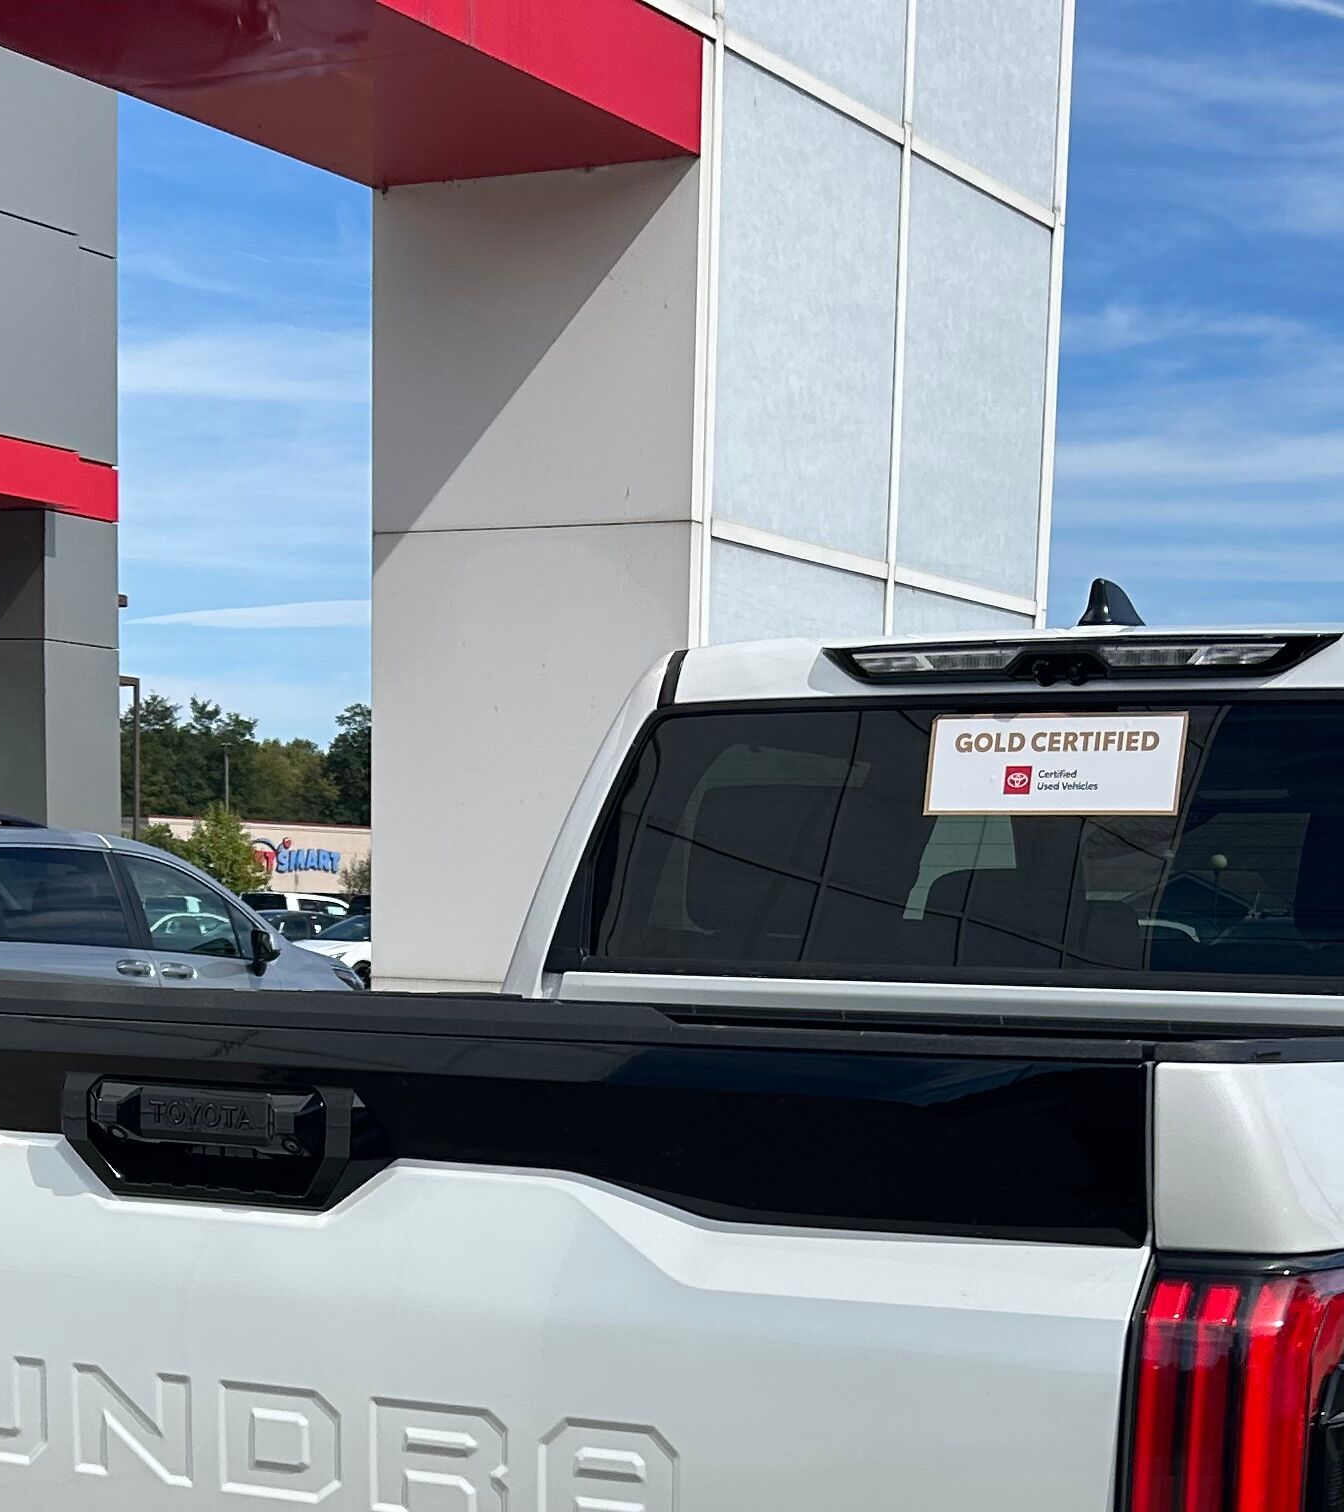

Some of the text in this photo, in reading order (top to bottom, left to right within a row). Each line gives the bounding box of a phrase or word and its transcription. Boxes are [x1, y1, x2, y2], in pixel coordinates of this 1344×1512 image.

[955, 731, 1160, 753] GOLD CERTIFIED
[1038, 769, 1077, 779] Certified
[1037, 781, 1098, 791] Used Vehicles
[150, 1100, 252, 1129] TOYOTA
